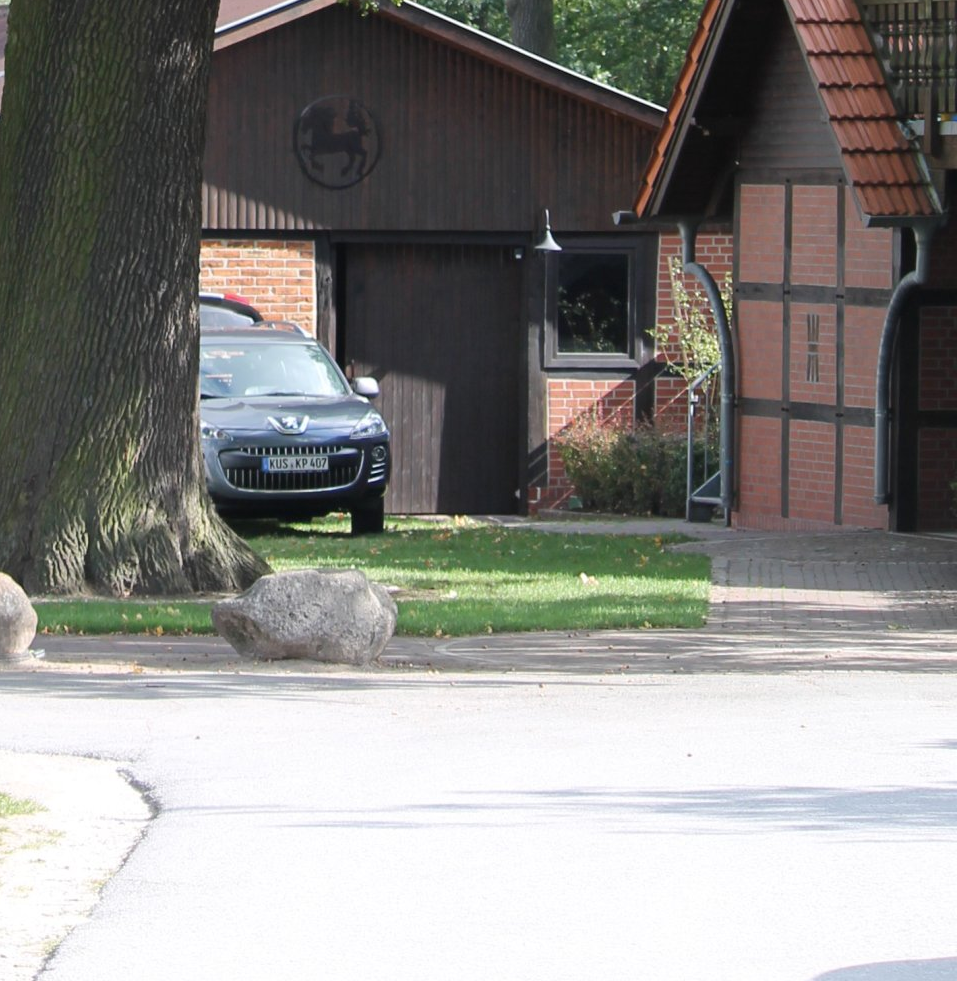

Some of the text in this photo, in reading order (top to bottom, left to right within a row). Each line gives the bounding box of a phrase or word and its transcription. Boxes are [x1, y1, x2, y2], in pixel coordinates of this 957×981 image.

[269, 457, 327, 469] KUS KP 407
